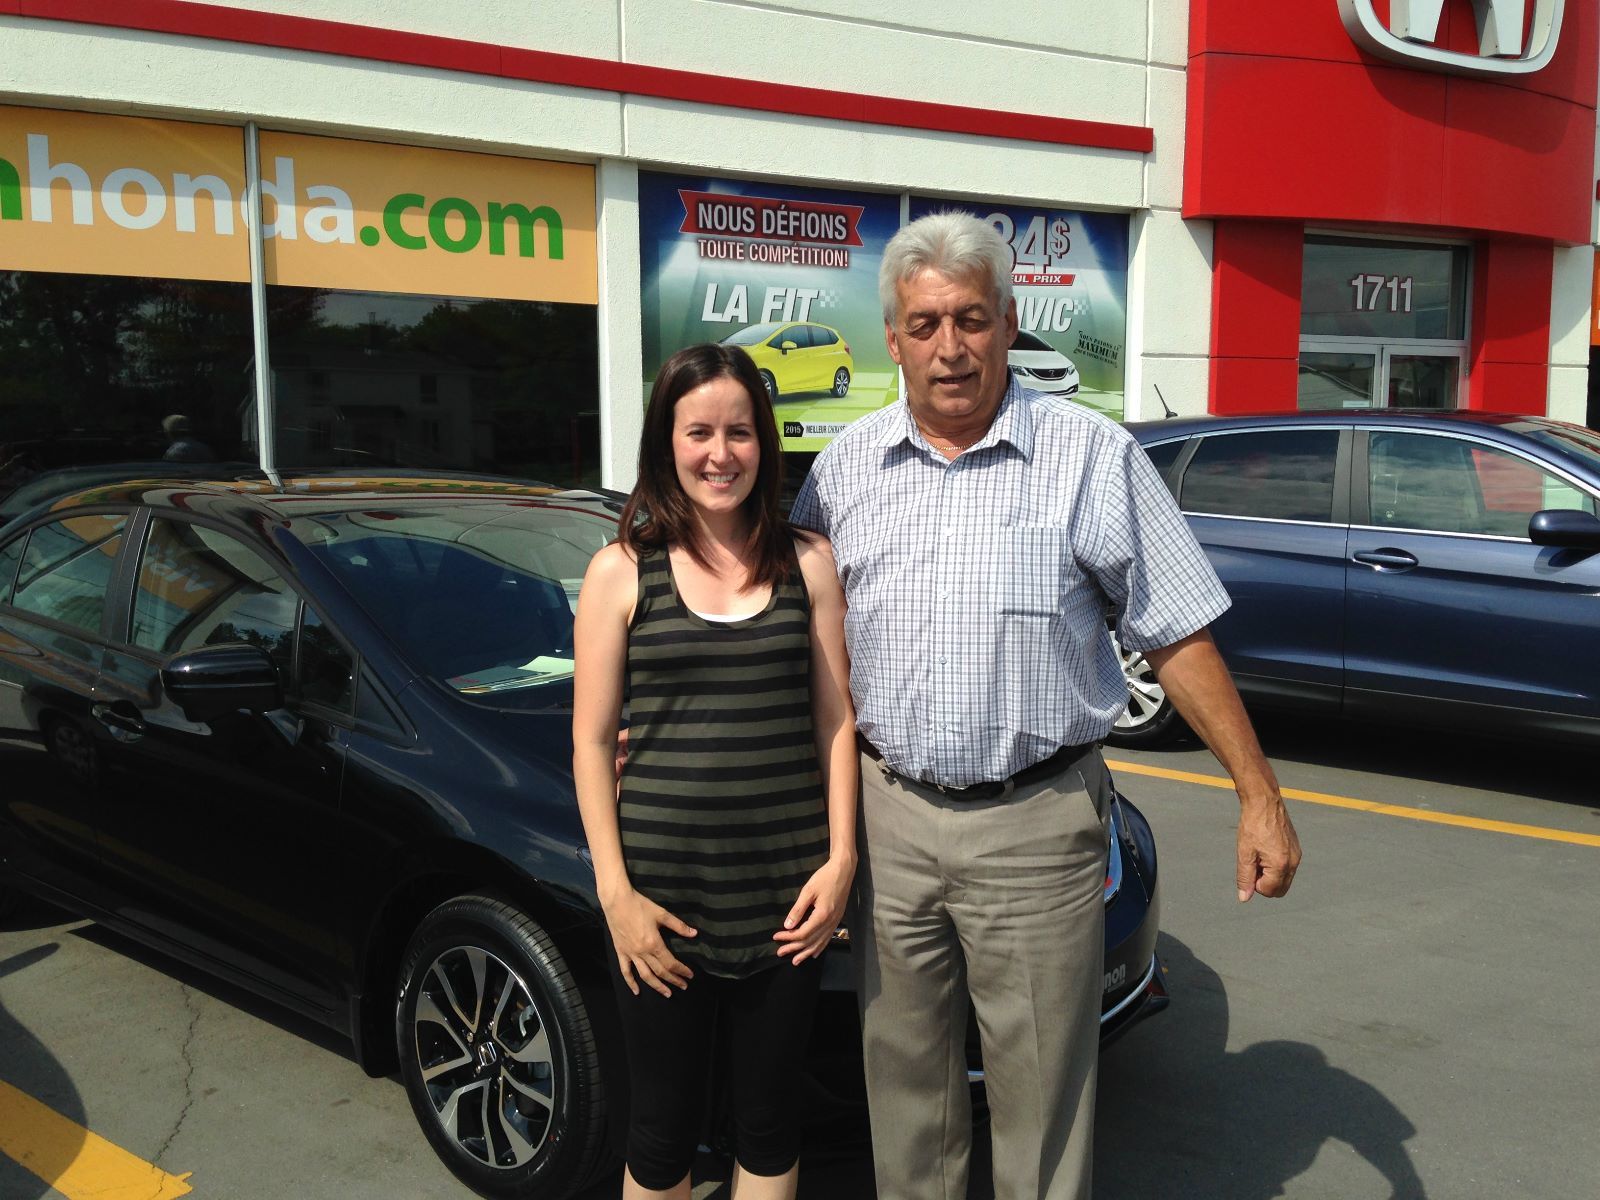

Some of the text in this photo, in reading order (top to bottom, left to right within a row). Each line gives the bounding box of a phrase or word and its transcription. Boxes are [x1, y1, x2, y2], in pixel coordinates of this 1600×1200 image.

[698, 202, 847, 240] NOUS DÉFIONS
[698, 239, 848, 267] TOUTE COMPÉTITION!
[1012, 275, 1062, 283] UL PRIX
[1352, 274, 1412, 312] 1711
[702, 283, 819, 323] LA FIT
[1017, 296, 1074, 333] IVIC
[1078, 339, 1118, 360] MAXIMUM
[785, 425, 801, 434] 2015
